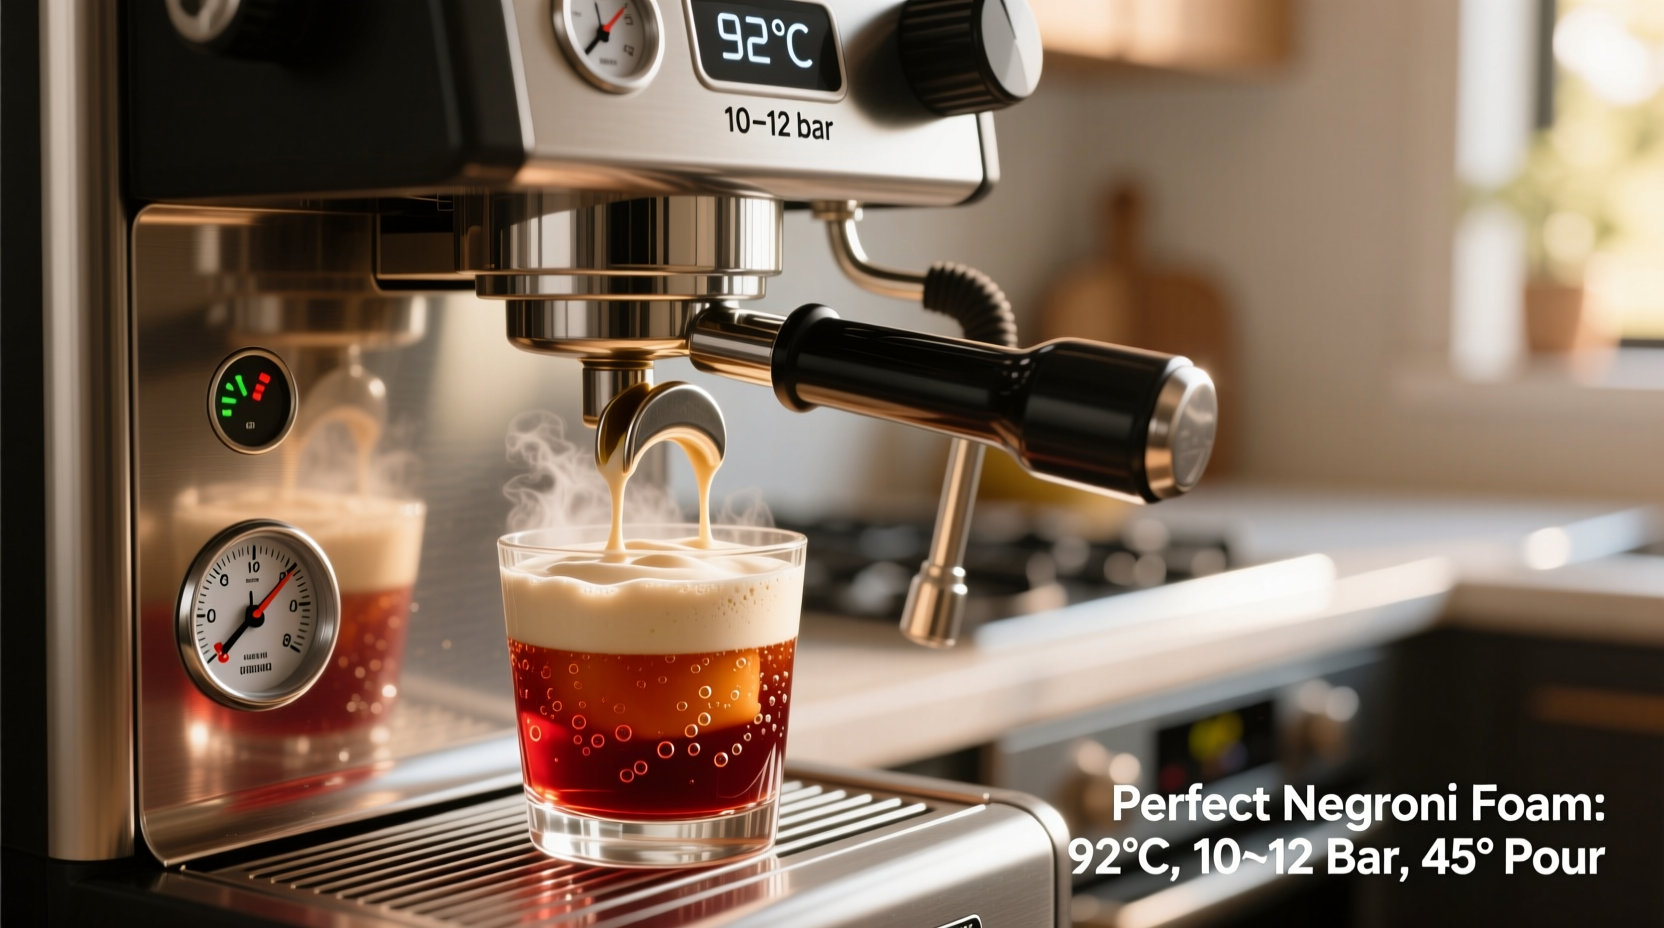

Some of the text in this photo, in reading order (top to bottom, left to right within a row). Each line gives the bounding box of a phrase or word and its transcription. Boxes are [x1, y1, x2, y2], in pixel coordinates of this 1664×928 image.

[717, 12, 813, 69] 92°C
[797, 111, 834, 141] bar
[248, 561, 261, 574] 10
